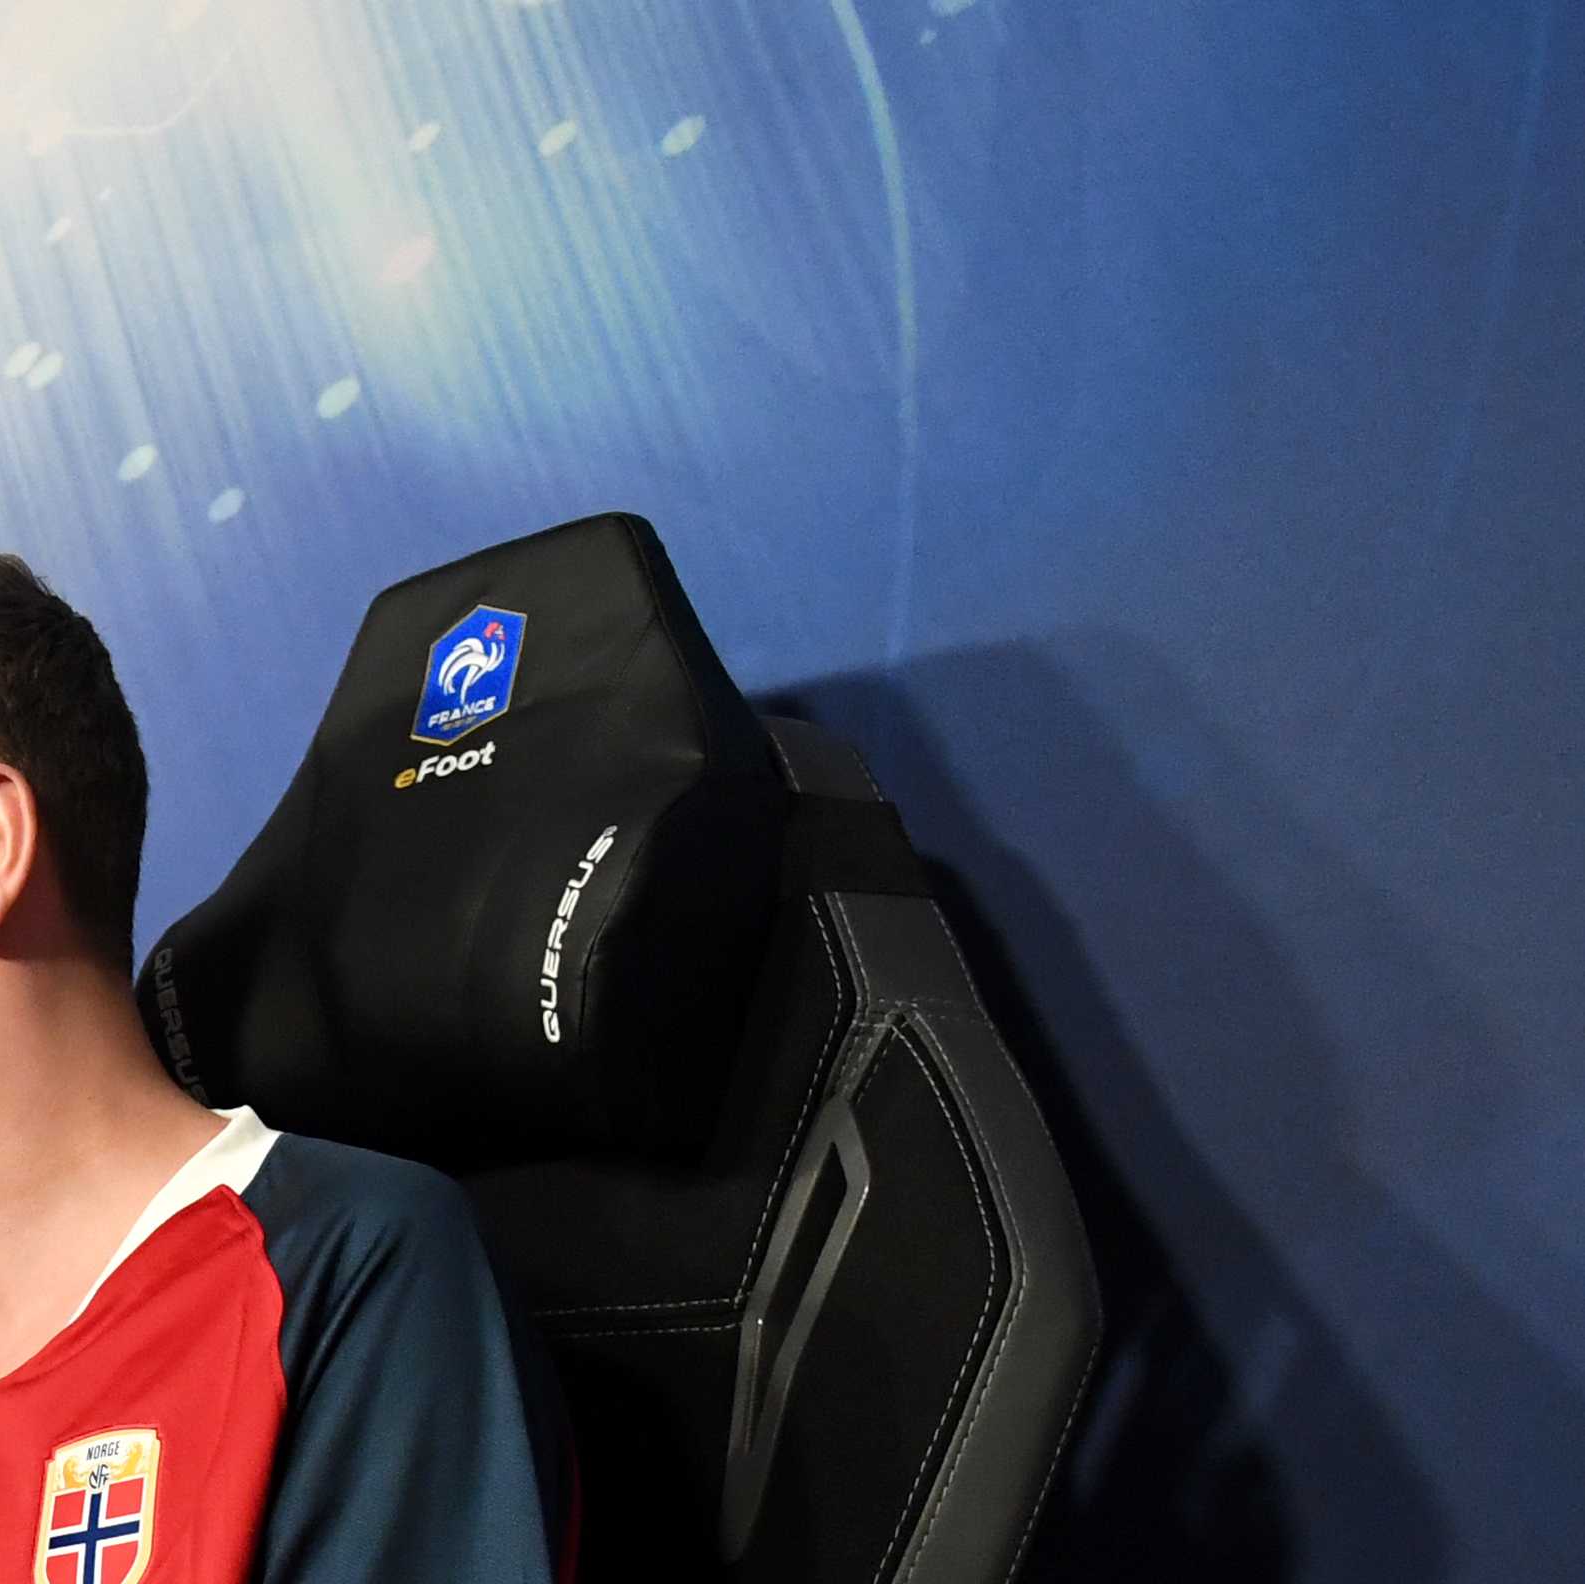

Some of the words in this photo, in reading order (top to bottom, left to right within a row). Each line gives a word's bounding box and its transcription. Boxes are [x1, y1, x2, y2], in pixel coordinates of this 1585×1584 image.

[427, 696, 497, 728] FRANCE
[394, 740, 497, 789] eFoot
[86, 1440, 121, 1461] NORGE
